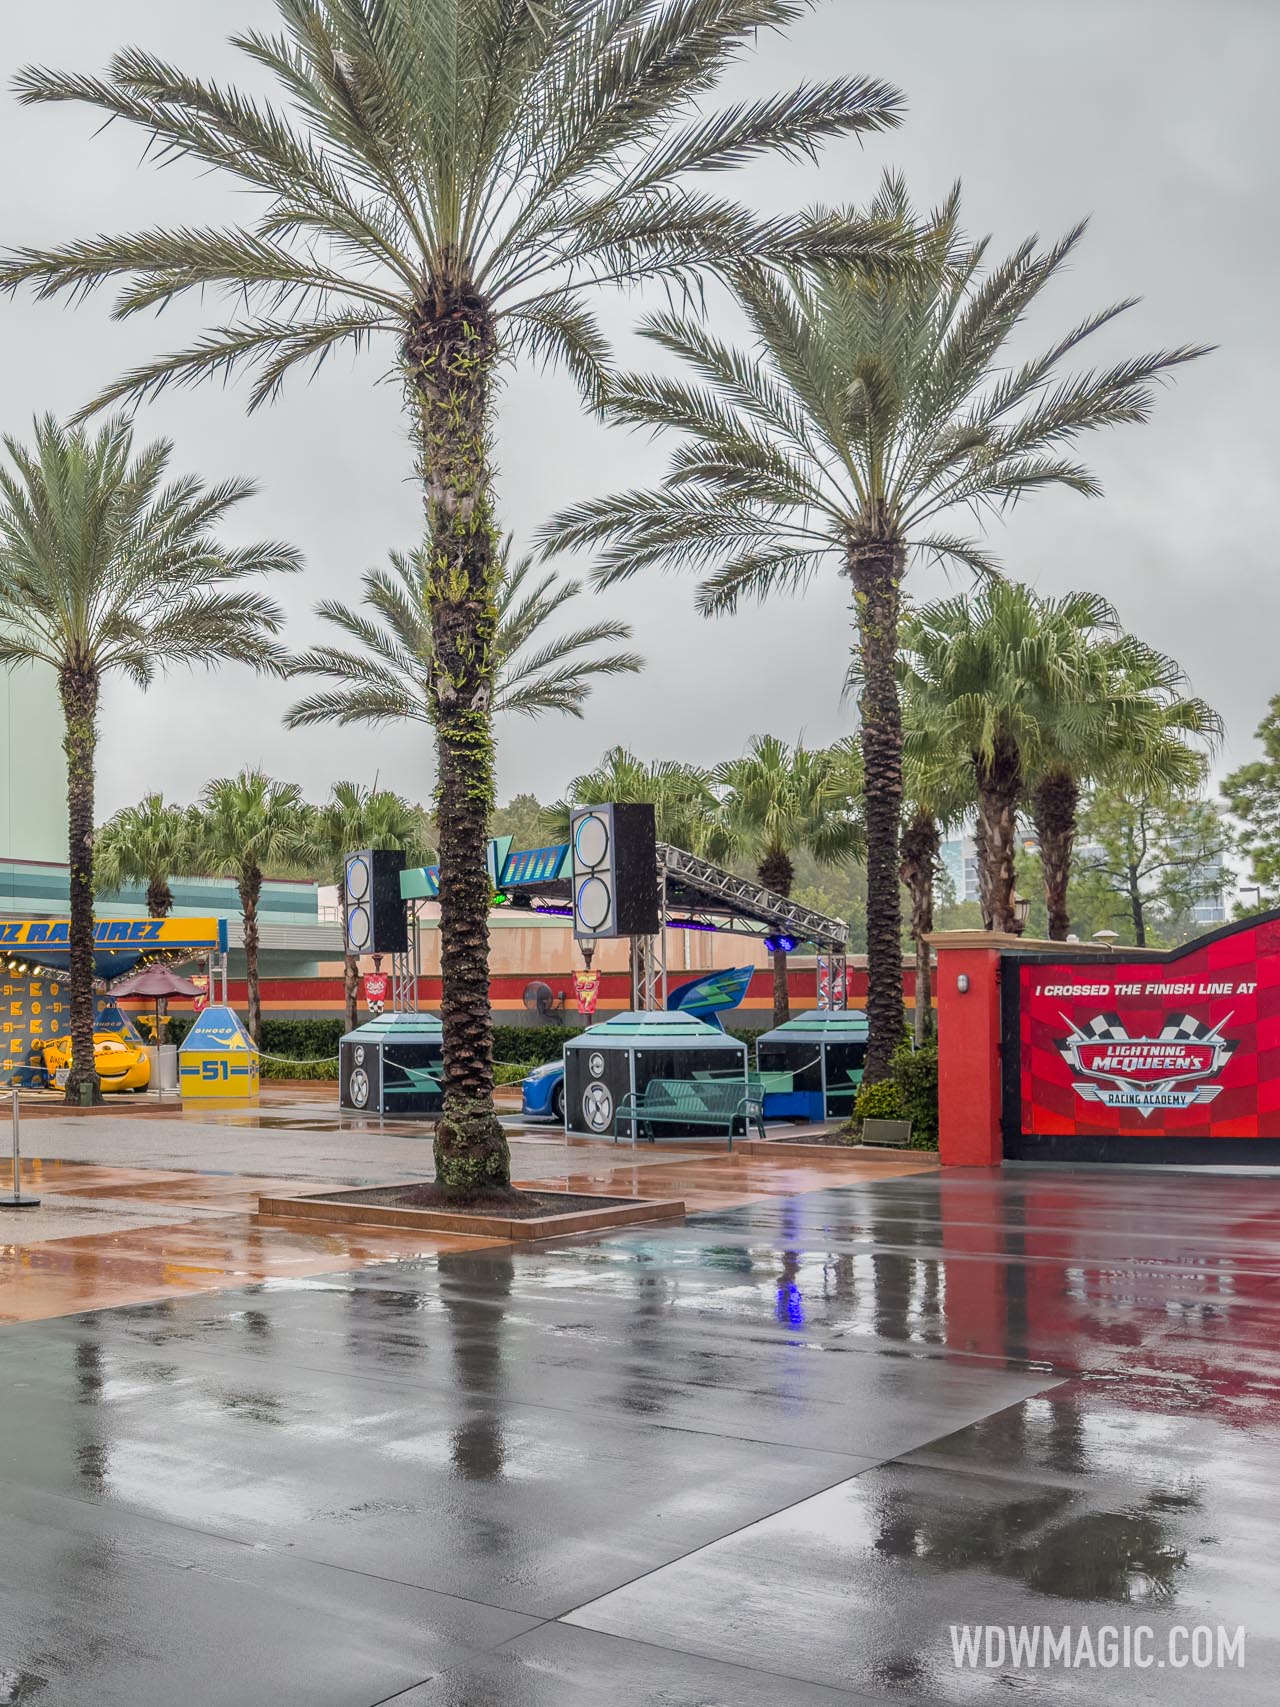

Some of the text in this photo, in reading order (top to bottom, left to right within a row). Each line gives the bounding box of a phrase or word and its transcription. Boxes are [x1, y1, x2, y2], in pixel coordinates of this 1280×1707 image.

[26, 921, 166, 942] RAIREZ
[1035, 982, 1257, 996] I CROSSED THE FINISH LINE AT
[1107, 1045, 1186, 1057] LIGHTNING
[202, 1060, 229, 1081] 51
[1092, 1054, 1203, 1072] MCQUEEN'S
[1108, 1093, 1186, 1106] RACING ACADEMY
